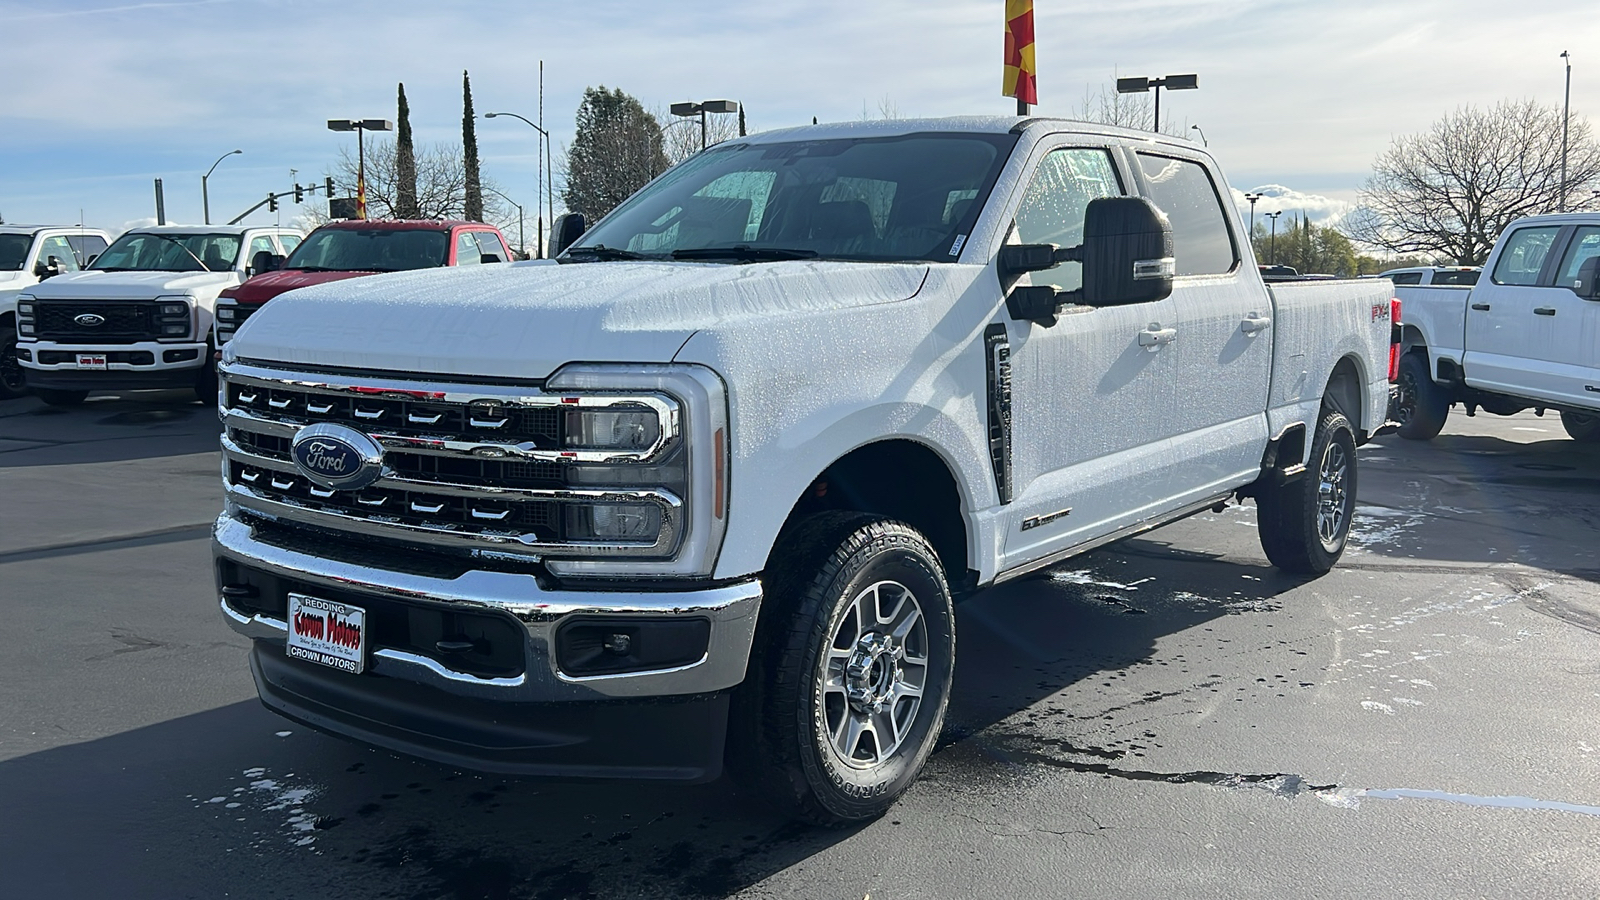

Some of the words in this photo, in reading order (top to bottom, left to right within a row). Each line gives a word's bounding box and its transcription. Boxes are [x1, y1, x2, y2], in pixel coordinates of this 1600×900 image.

[81, 316, 98, 324] Ford
[306, 441, 347, 472] Ford
[305, 598, 345, 614] REDDING
[294, 611, 324, 640] Crown
[327, 611, 361, 650] Motors
[291, 646, 320, 662] CROWN
[321, 654, 356, 671] MOTORS
